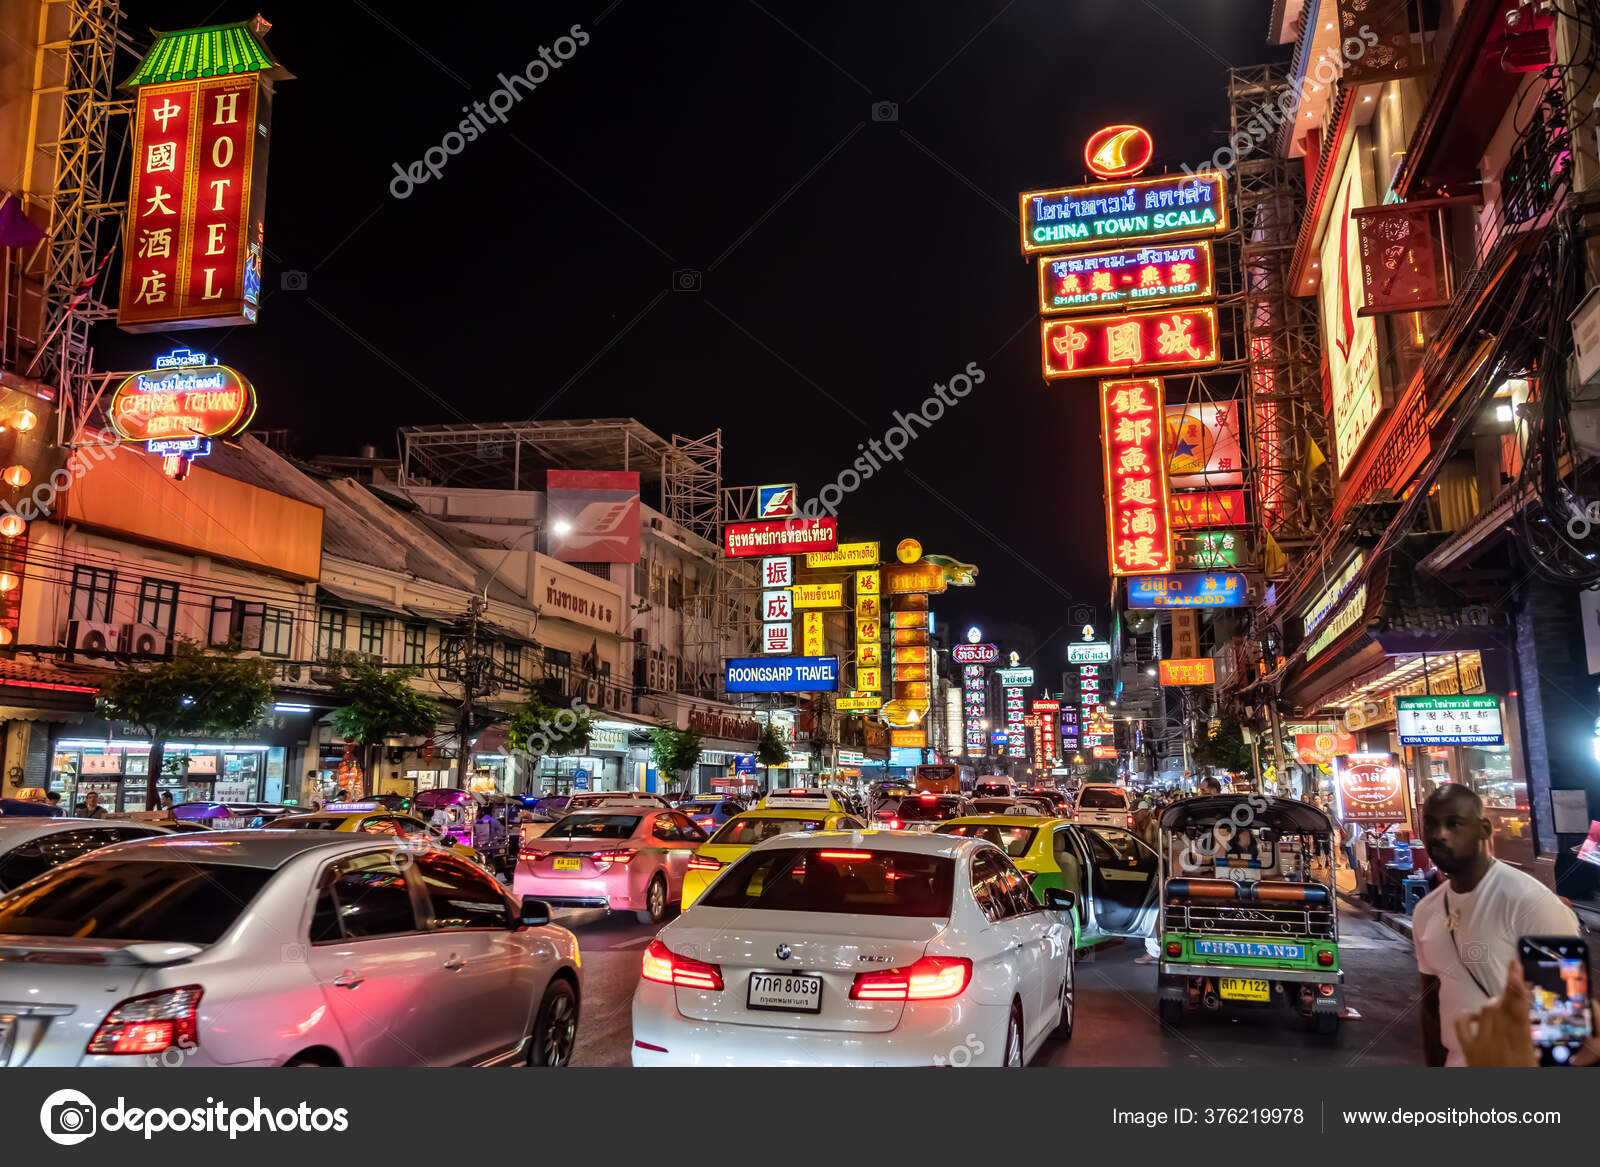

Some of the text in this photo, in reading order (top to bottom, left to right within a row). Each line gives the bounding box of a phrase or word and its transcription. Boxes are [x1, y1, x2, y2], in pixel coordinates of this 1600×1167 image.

[134, 98, 181, 305] 中國大酒店
[201, 93, 240, 300] HOTEL
[1033, 188, 1136, 221] ไชน่าทาวน์
[1033, 208, 1216, 242] CHINA TOWN SCALA
[1054, 291, 1098, 305] SHARK'S
[1131, 285, 1167, 297] BIRD'S
[1169, 282, 1198, 294] NEST
[1052, 315, 1201, 370] 中國城
[184, 391, 239, 411] TOWN
[728, 521, 833, 554] รุ่งทรัพย์การท่องเที่ยว
[767, 561, 789, 651] 振成豐
[1153, 595, 1225, 606] SEAFOOD
[728, 665, 835, 682] ROONGSARP TRAVEL
[1201, 942, 1298, 957] THAILAND
[755, 976, 818, 994] 7กค 8059
[1241, 979, 1268, 993] 7122
